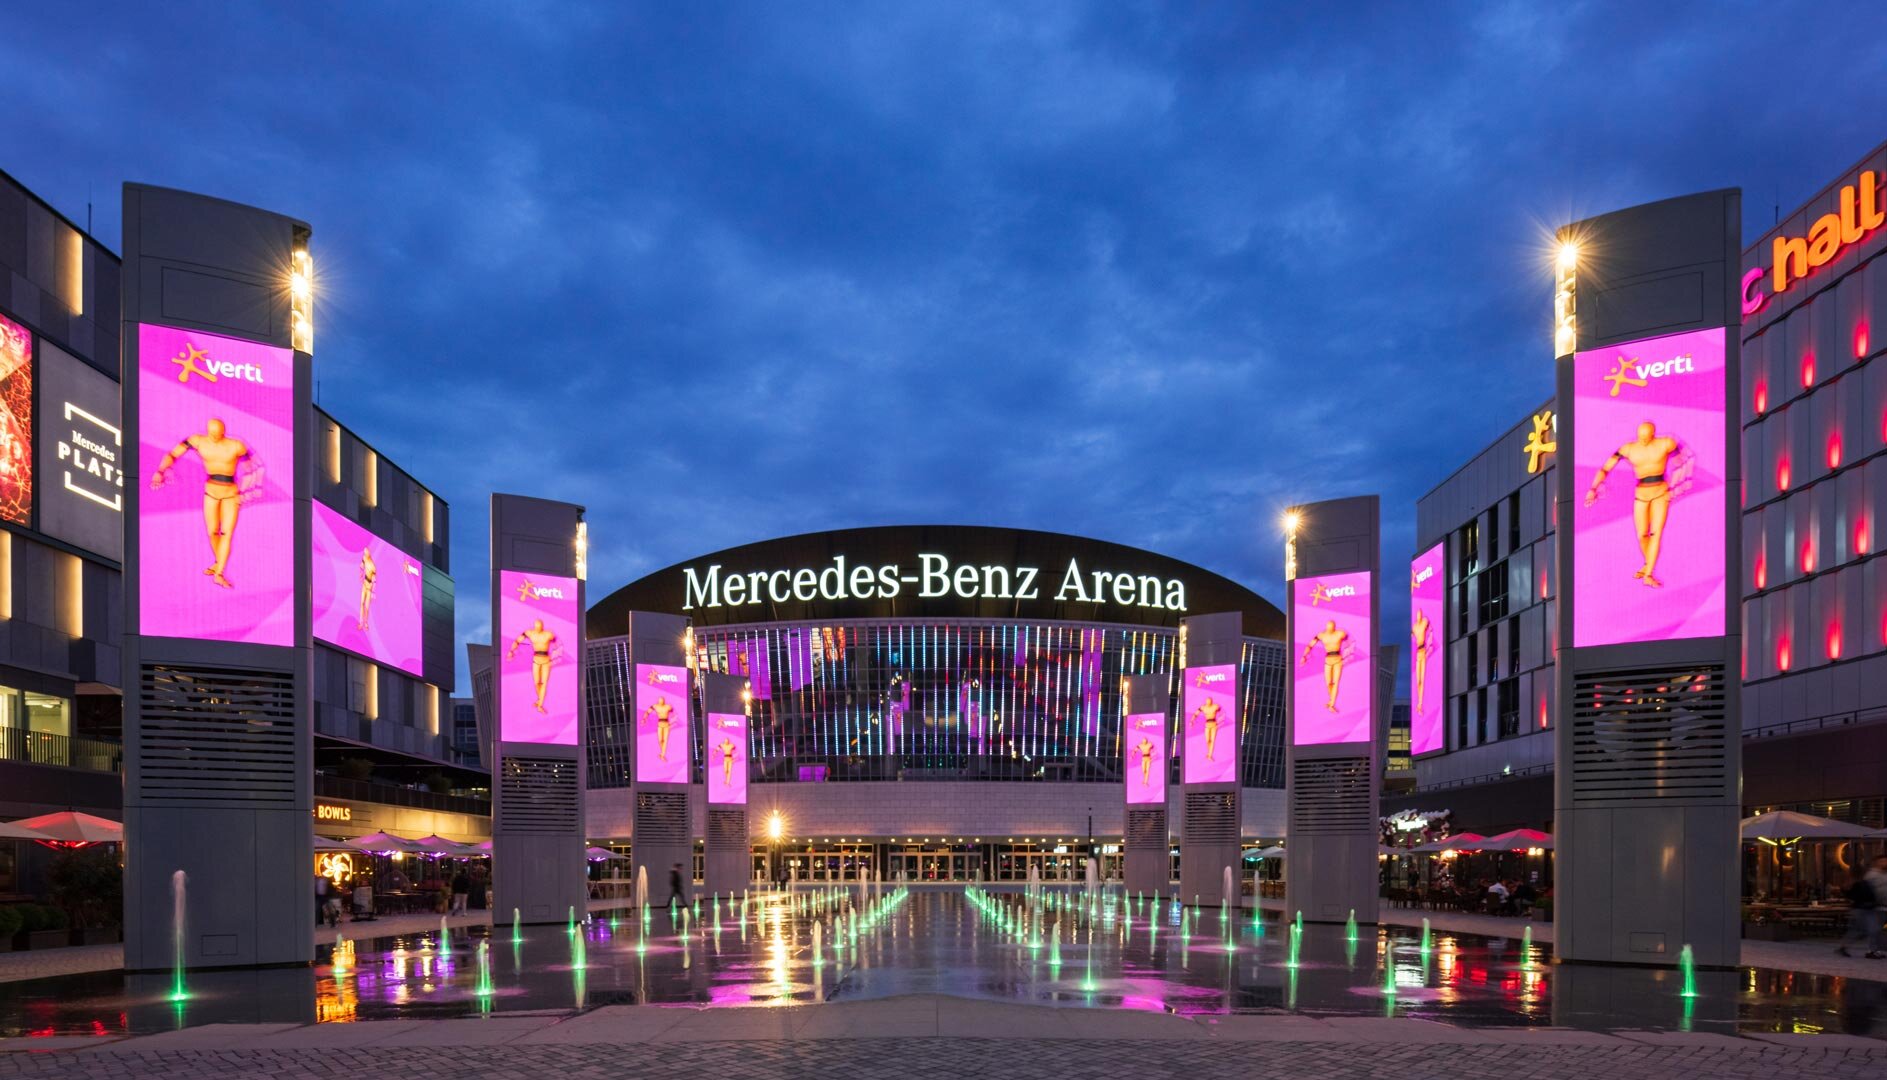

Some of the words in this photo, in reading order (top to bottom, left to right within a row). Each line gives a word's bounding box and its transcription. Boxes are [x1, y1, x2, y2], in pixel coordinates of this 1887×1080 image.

[1773, 171, 1885, 293] hall
[205, 358, 264, 384] verti
[1636, 353, 1695, 380] verti
[72, 430, 115, 462] Mercedes
[533, 587, 563, 600] verti
[682, 553, 1039, 610] Mercedes-Benz
[1053, 557, 1188, 612] Arena
[1325, 585, 1355, 598] verti
[318, 805, 351, 821] BOWLS
